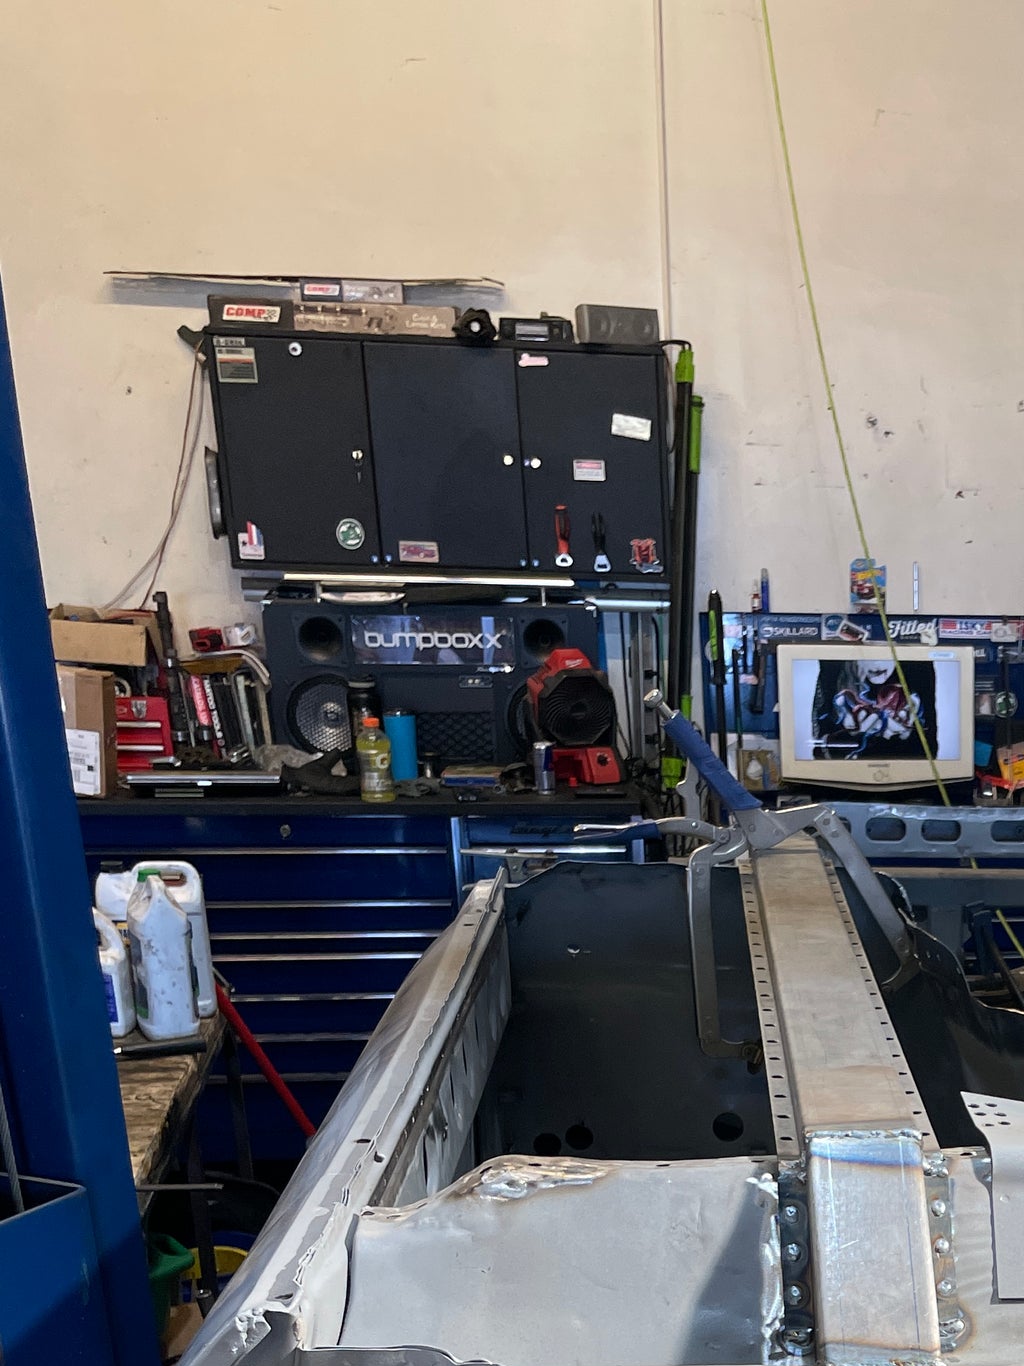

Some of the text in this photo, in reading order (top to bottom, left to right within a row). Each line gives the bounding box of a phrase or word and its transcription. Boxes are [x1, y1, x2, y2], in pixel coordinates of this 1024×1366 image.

[226, 306, 266, 319] COMP
[888, 618, 938, 639] Fitted
[364, 630, 503, 651] bumpboxx
